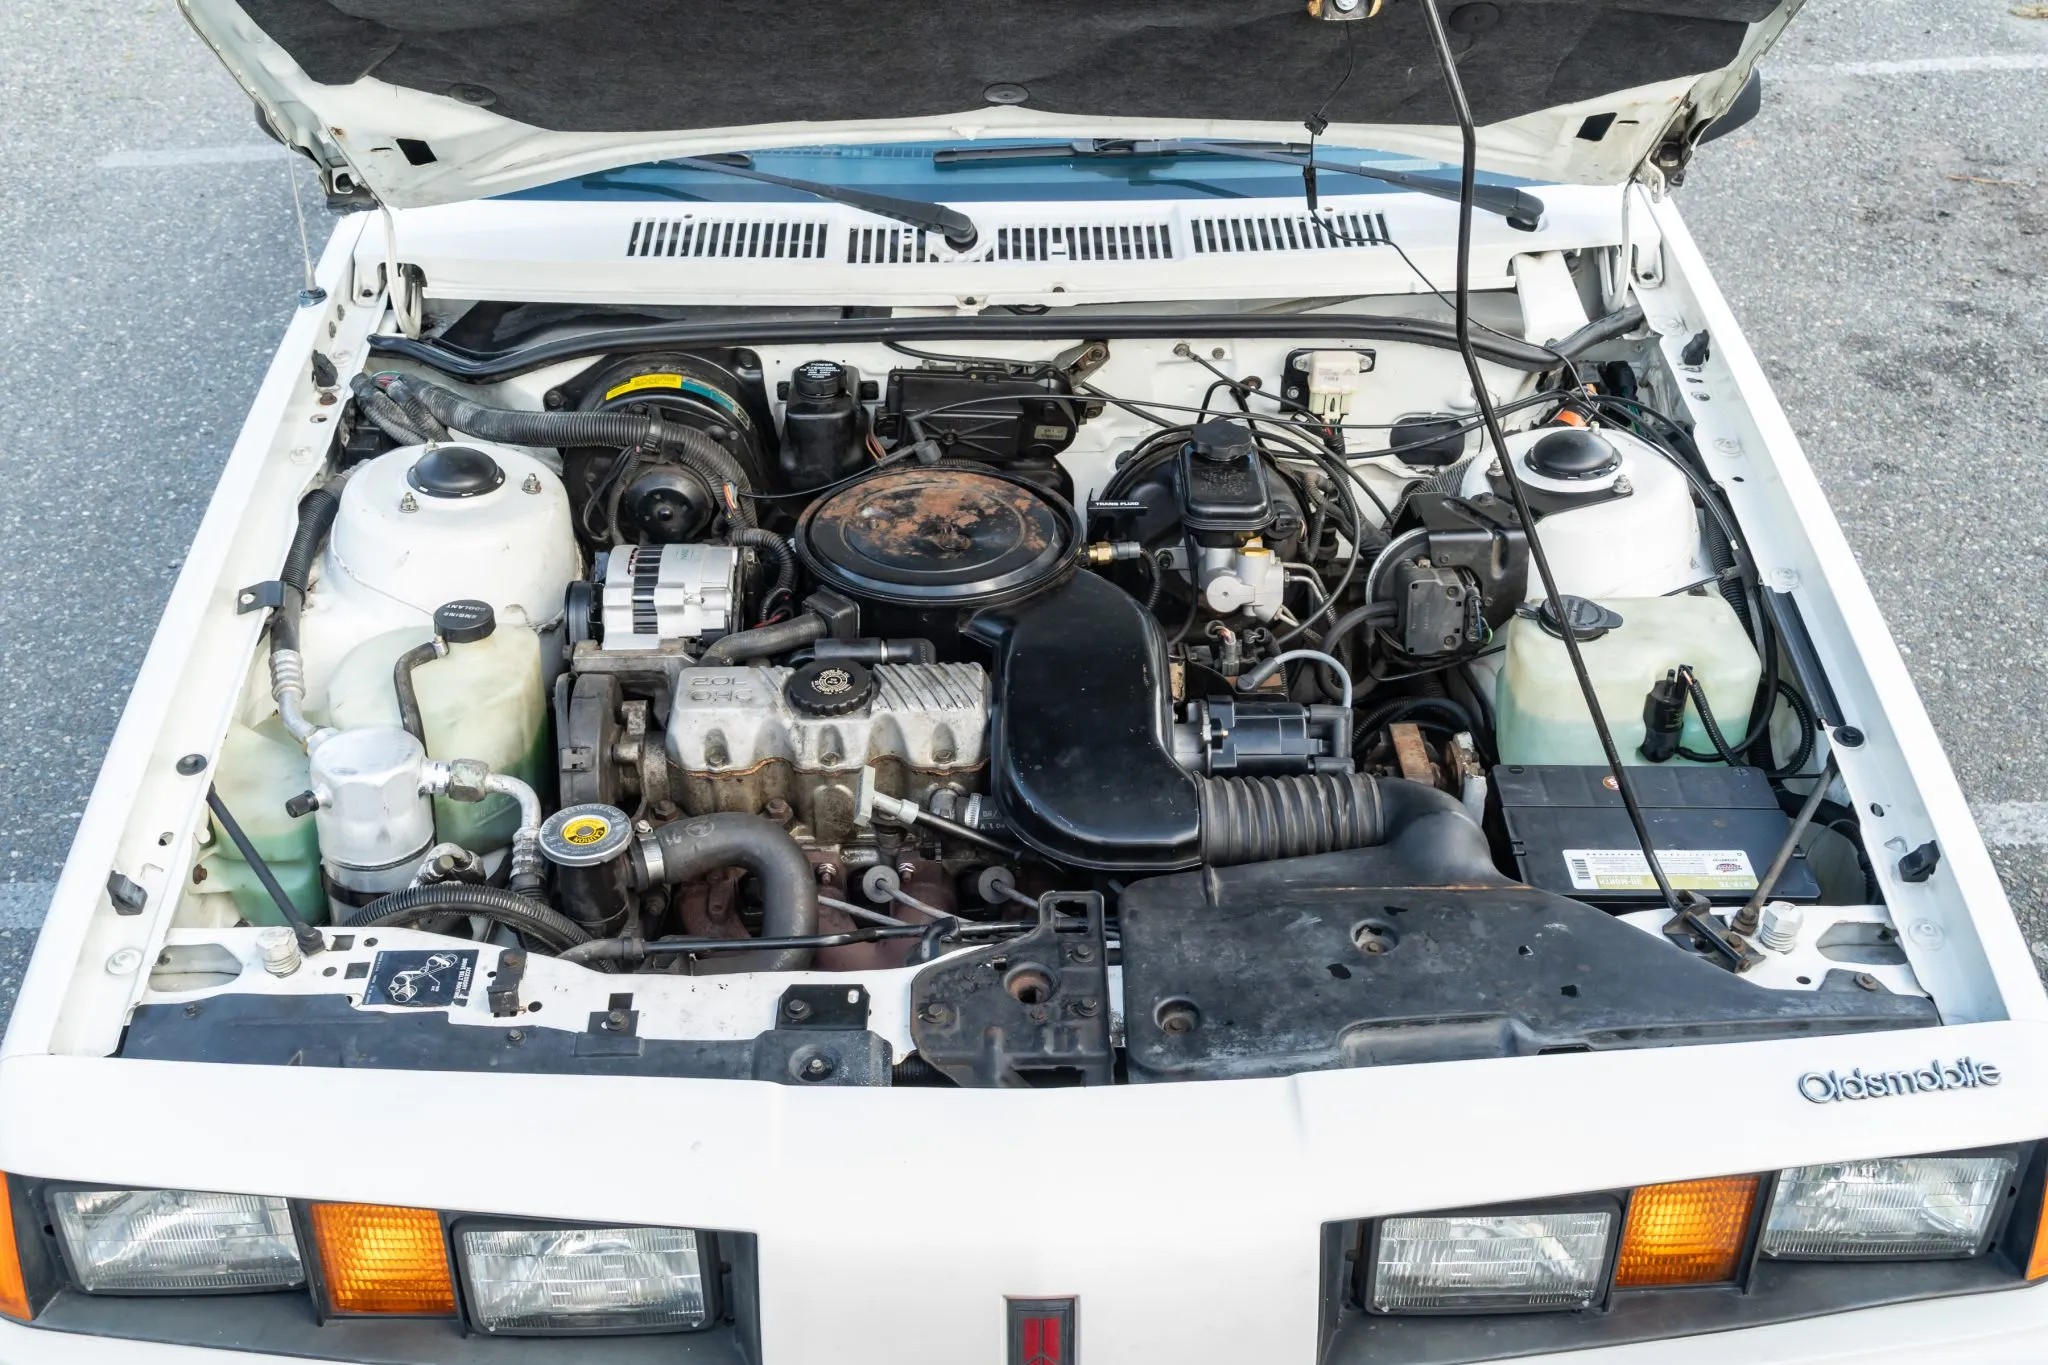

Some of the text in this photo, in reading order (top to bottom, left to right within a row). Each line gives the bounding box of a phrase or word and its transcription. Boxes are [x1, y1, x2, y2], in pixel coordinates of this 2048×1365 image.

[443, 611, 478, 619] ENGINE
[690, 689, 753, 702] OHC
[573, 828, 604, 843] CAUTION
[1798, 1056, 2002, 1104] Oldsmobile
